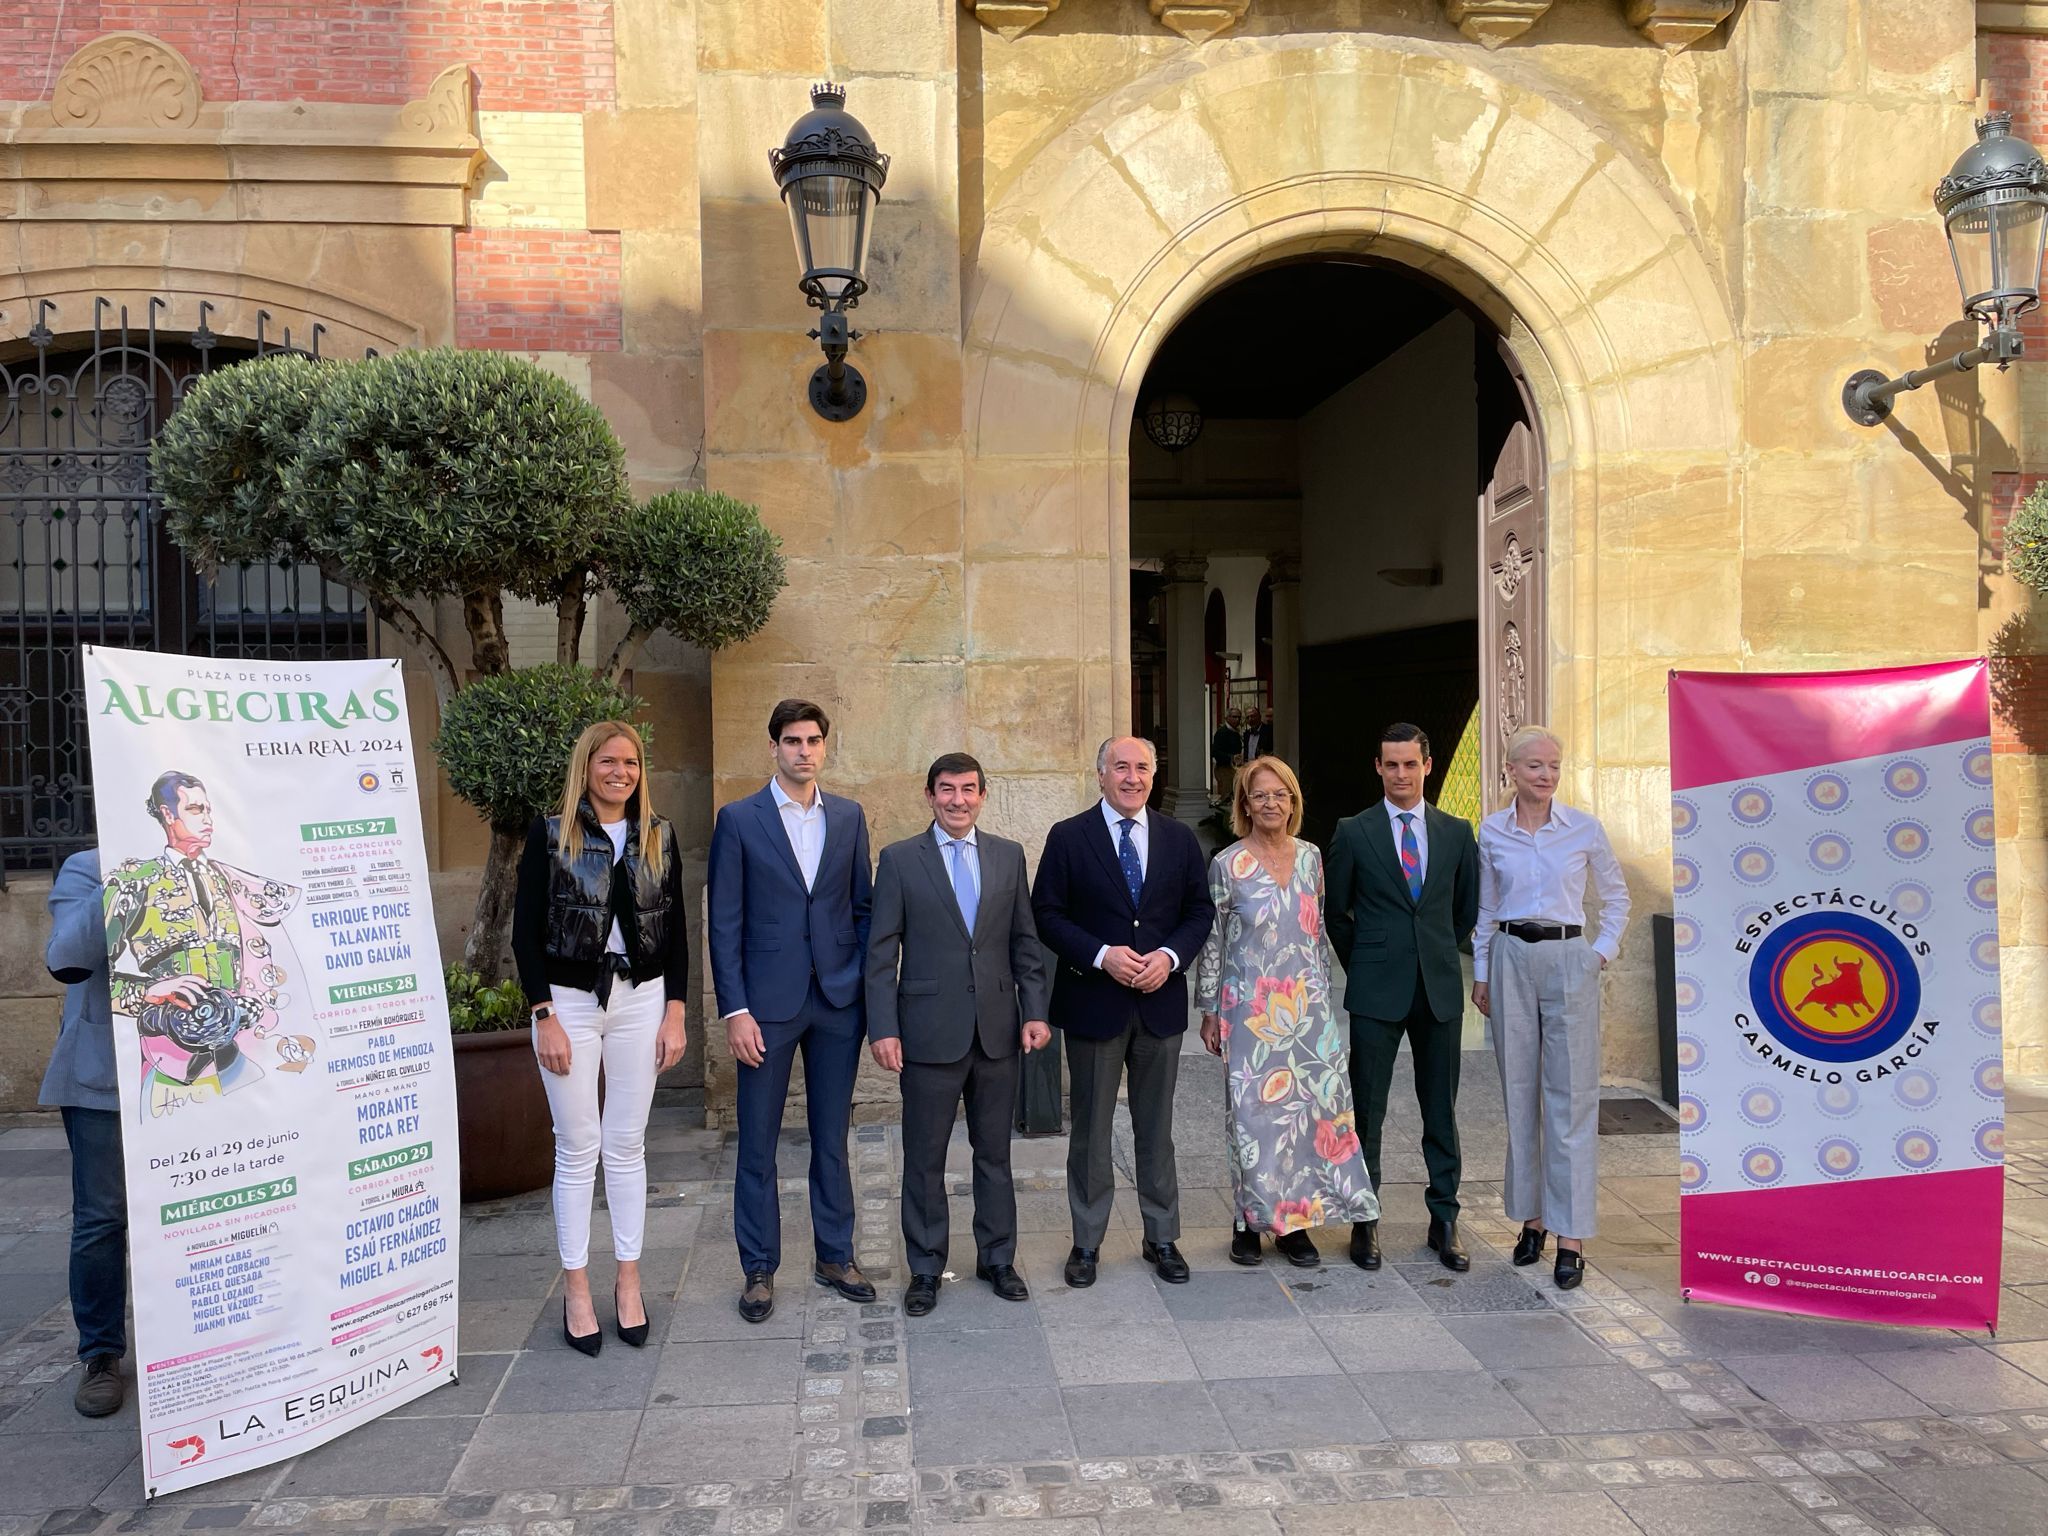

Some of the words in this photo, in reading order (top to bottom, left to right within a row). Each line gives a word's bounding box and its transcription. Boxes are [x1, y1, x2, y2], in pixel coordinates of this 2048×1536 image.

[188, 670, 232, 680] PLAZA
[239, 673, 257, 682] DE
[264, 674, 312, 682] TOROS
[100, 678, 399, 729] ALGECIRAS
[246, 742, 302, 756] FERIA
[309, 740, 355, 757] REAL
[360, 739, 403, 752] 2024
[312, 823, 364, 840] JUEVES
[367, 821, 386, 833] 27
[300, 846, 345, 854] CORRIDA
[349, 840, 402, 850] CONCURSO
[312, 907, 369, 928] ENRIQUE
[372, 902, 411, 920] PONCE
[1735, 888, 1931, 957] ESPECTÁCULOS
[330, 924, 401, 947] TALAVANTE
[326, 951, 363, 970] DAVID
[368, 941, 411, 963] GALVÁN
[333, 981, 393, 1000] VIERNES
[396, 977, 413, 990] 28
[313, 1008, 357, 1020] CORRIDA
[377, 1000, 405, 1009] TOROS
[410, 995, 435, 1004] MIXTA
[359, 1016, 382, 1029] FERMÍN
[384, 1012, 418, 1025] BOHÓRQUEZ
[368, 1034, 395, 1049] PABLO
[1735, 1013, 1842, 1084] CARMELO
[1856, 1020, 1940, 1083] GARCÍA
[328, 1053, 375, 1073] HERMOSO
[379, 1050, 390, 1063] DE
[393, 1042, 434, 1060] MENDOZA
[366, 1070, 385, 1082] NÚÑEZ
[387, 1069, 398, 1078] DEL
[400, 1063, 422, 1075] CUVILLO
[355, 1089, 380, 1099] MANO
[394, 1081, 418, 1091] MANO
[357, 1094, 418, 1122] MORANTE
[359, 1122, 393, 1144] ROCA
[398, 1114, 419, 1135] REY
[150, 1155, 174, 1169] Del
[179, 1147, 200, 1164] 26
[205, 1146, 217, 1159] al
[222, 1141, 242, 1155] 29
[247, 1139, 264, 1150] de
[267, 1130, 299, 1148] junio
[354, 1152, 408, 1176] SÁBADO
[411, 1146, 428, 1159] 29
[170, 1169, 206, 1188] 7:30
[211, 1166, 229, 1178] de
[234, 1162, 245, 1173] la
[250, 1154, 285, 1169] tarde
[349, 1179, 390, 1194] CORRIDA
[393, 1174, 404, 1183] DE
[408, 1165, 434, 1177] TOROS
[166, 1187, 266, 1221] MIÉRCOLES
[269, 1178, 293, 1197] 26
[392, 1184, 413, 1198] MIURA
[164, 1221, 222, 1240] NOVILLADA
[225, 1217, 241, 1226] SIN
[244, 1203, 297, 1222] PICADORES
[346, 1212, 394, 1240] OCTAVIO
[398, 1195, 439, 1224] CHACÓN
[231, 1224, 267, 1242] MIGUELÍN
[346, 1236, 376, 1264] ESAÚ
[380, 1218, 440, 1253] FERNÁNDEZ
[176, 1269, 224, 1288] GUILLERMO
[227, 1256, 270, 1276] CORBACHO
[190, 1256, 222, 1272] MIRIAM
[225, 1249, 252, 1263] CABAS
[340, 1261, 383, 1289] MIGUEL
[387, 1258, 397, 1273] A.
[401, 1238, 446, 1268] PACHECO
[1698, 1251, 1983, 1284] WWW.ESPECTACULOSCARMELOGARCIA.COM
[190, 1281, 221, 1297] RAFAEL
[225, 1270, 262, 1288] QUESADA
[192, 1294, 219, 1308] PABLO
[223, 1285, 254, 1301] LOZANO
[1786, 1278, 1937, 1300] @espectaculoscarmelogarcia
[194, 1305, 224, 1320] MIGUEL
[228, 1294, 263, 1312] VÁZQUEZ
[331, 1280, 453, 1331] www.espectaculoscarmelogarcia.com
[407, 1306, 421, 1318] 627
[423, 1298, 437, 1311] 696
[440, 1292, 453, 1304] 754
[194, 1318, 225, 1334] JUANMI
[228, 1310, 251, 1325] VIDAL
[151, 1360, 175, 1370] VENTA
[219, 1414, 266, 1440] LA
[285, 1358, 409, 1422] ESQUINA
[257, 1428, 284, 1442] BAR
[302, 1386, 388, 1428] RESTAURANTE
